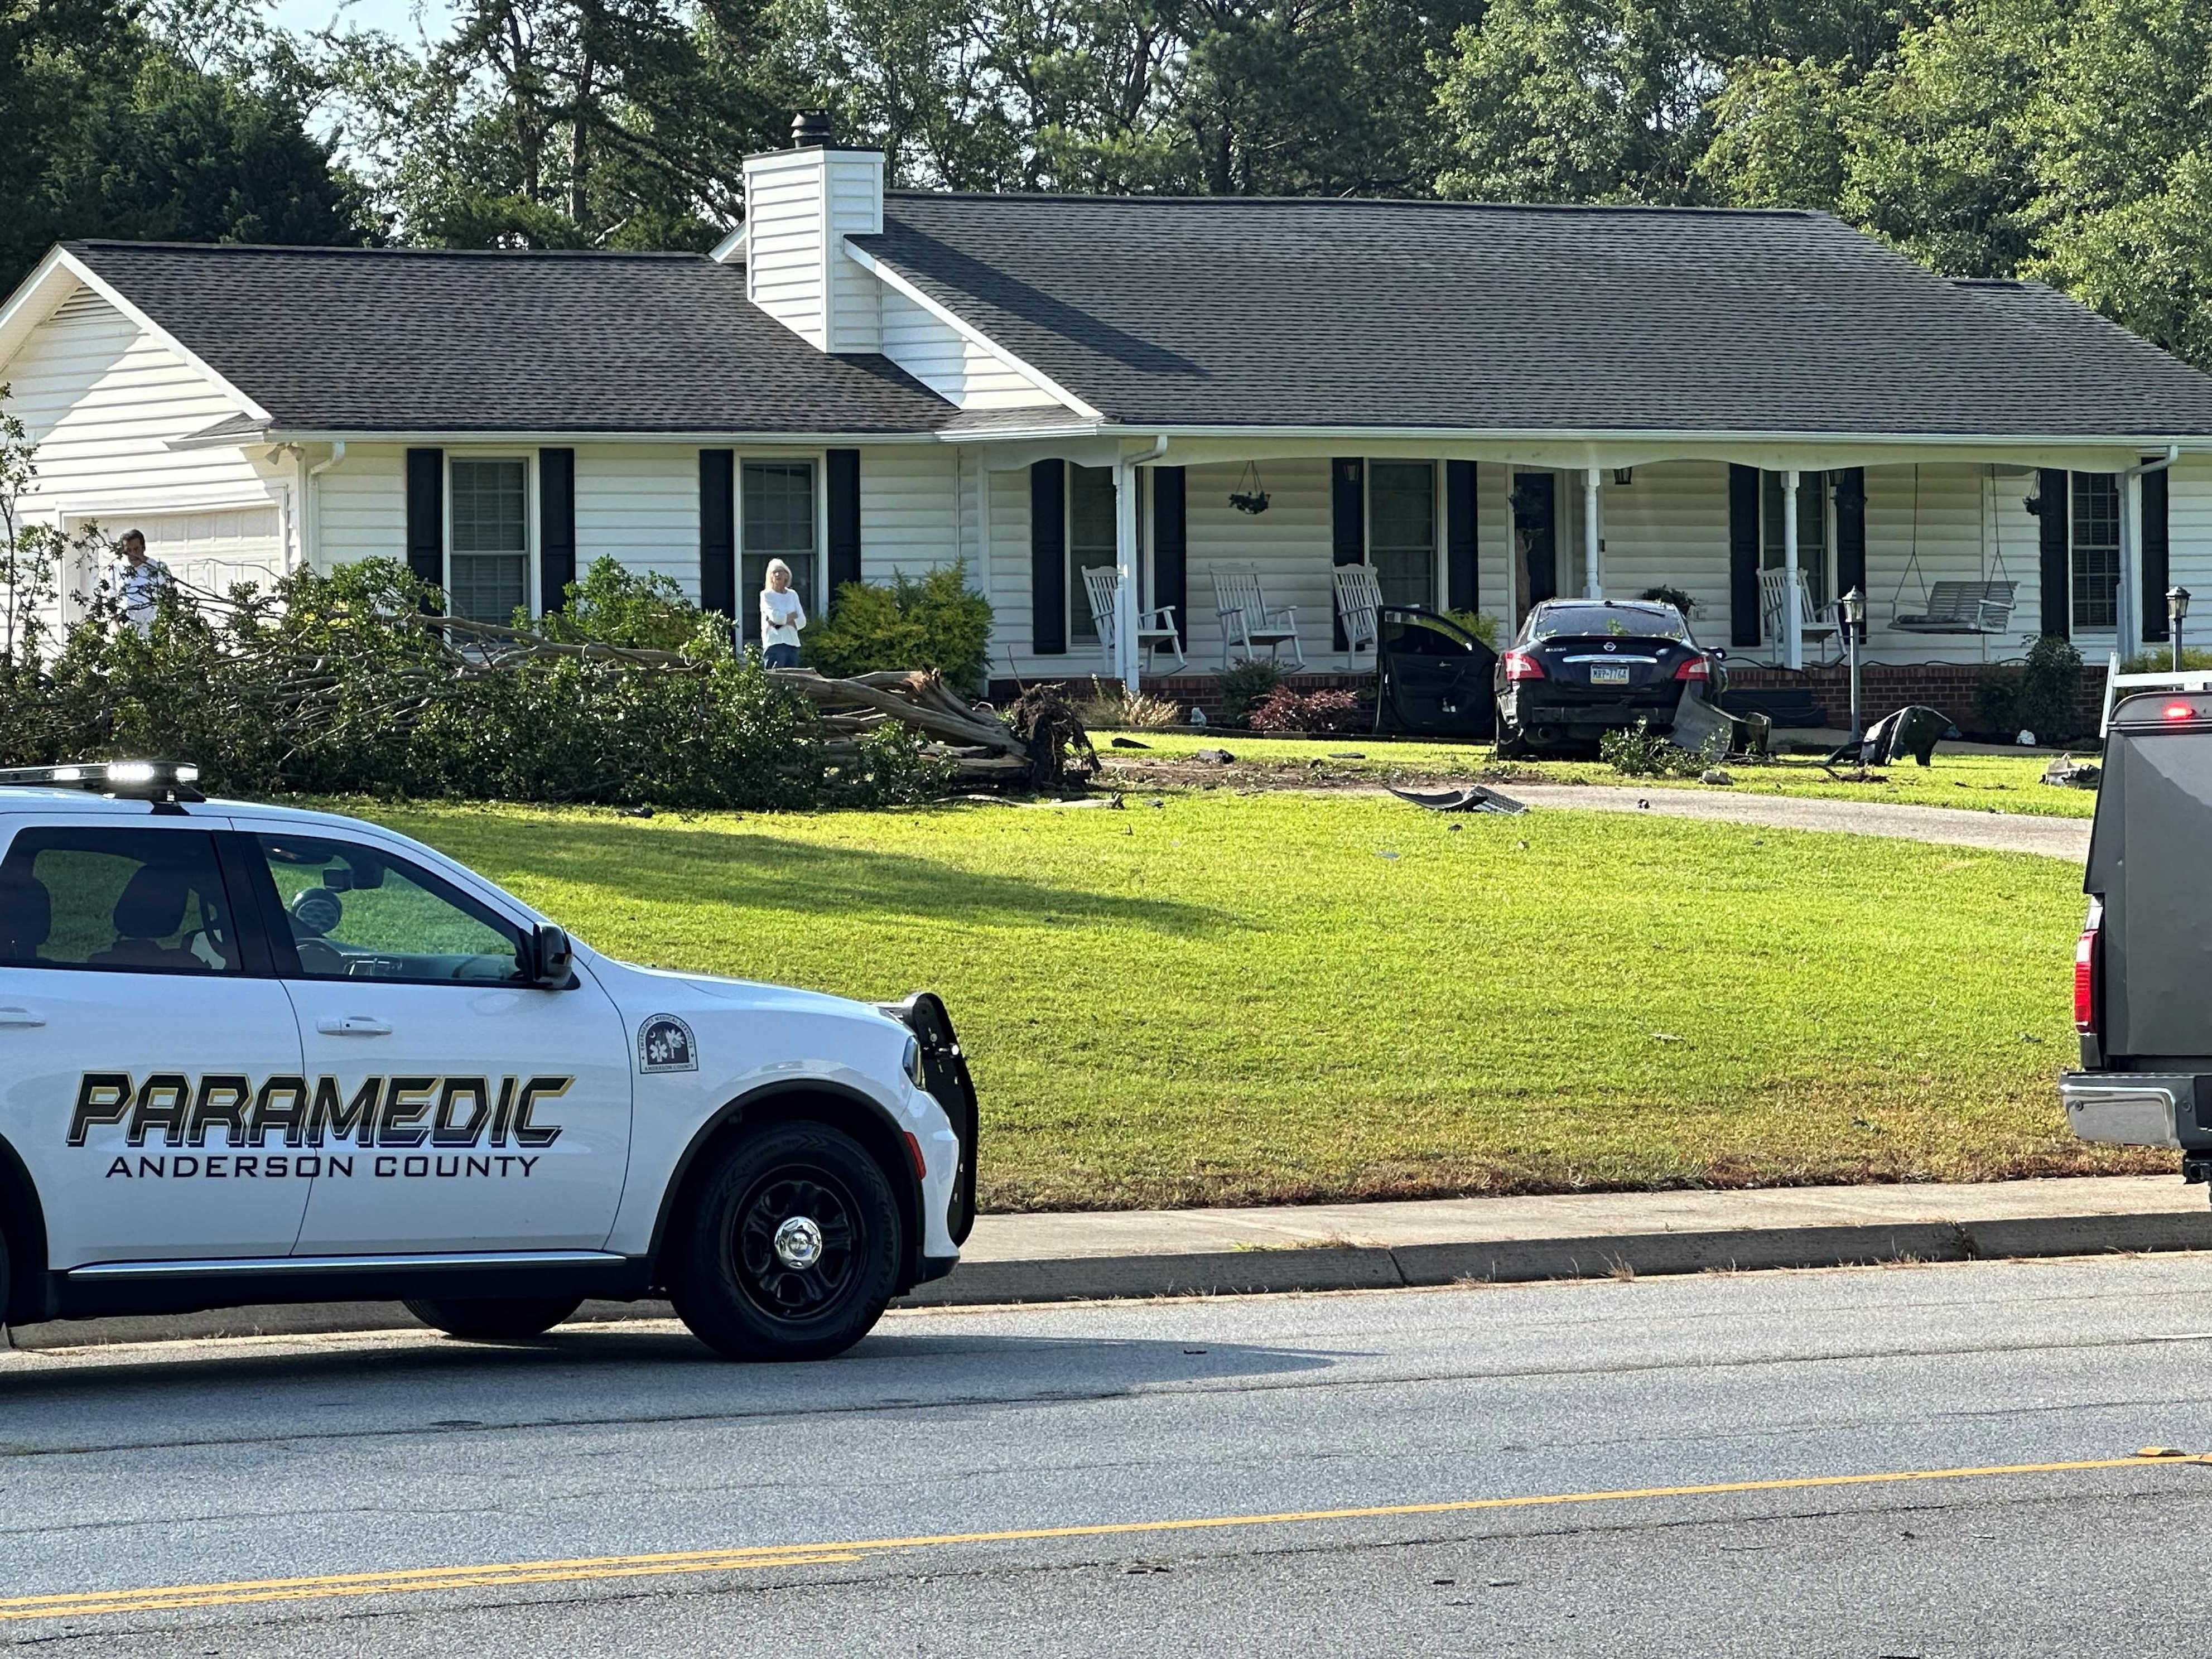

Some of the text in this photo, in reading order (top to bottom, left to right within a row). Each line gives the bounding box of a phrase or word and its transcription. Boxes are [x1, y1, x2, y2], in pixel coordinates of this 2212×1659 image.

[654, 1015, 678, 1024] MEDICAL
[66, 1071, 576, 1148] PARAMEDIC
[105, 1156, 539, 1178] ANDERSON COUNTY
